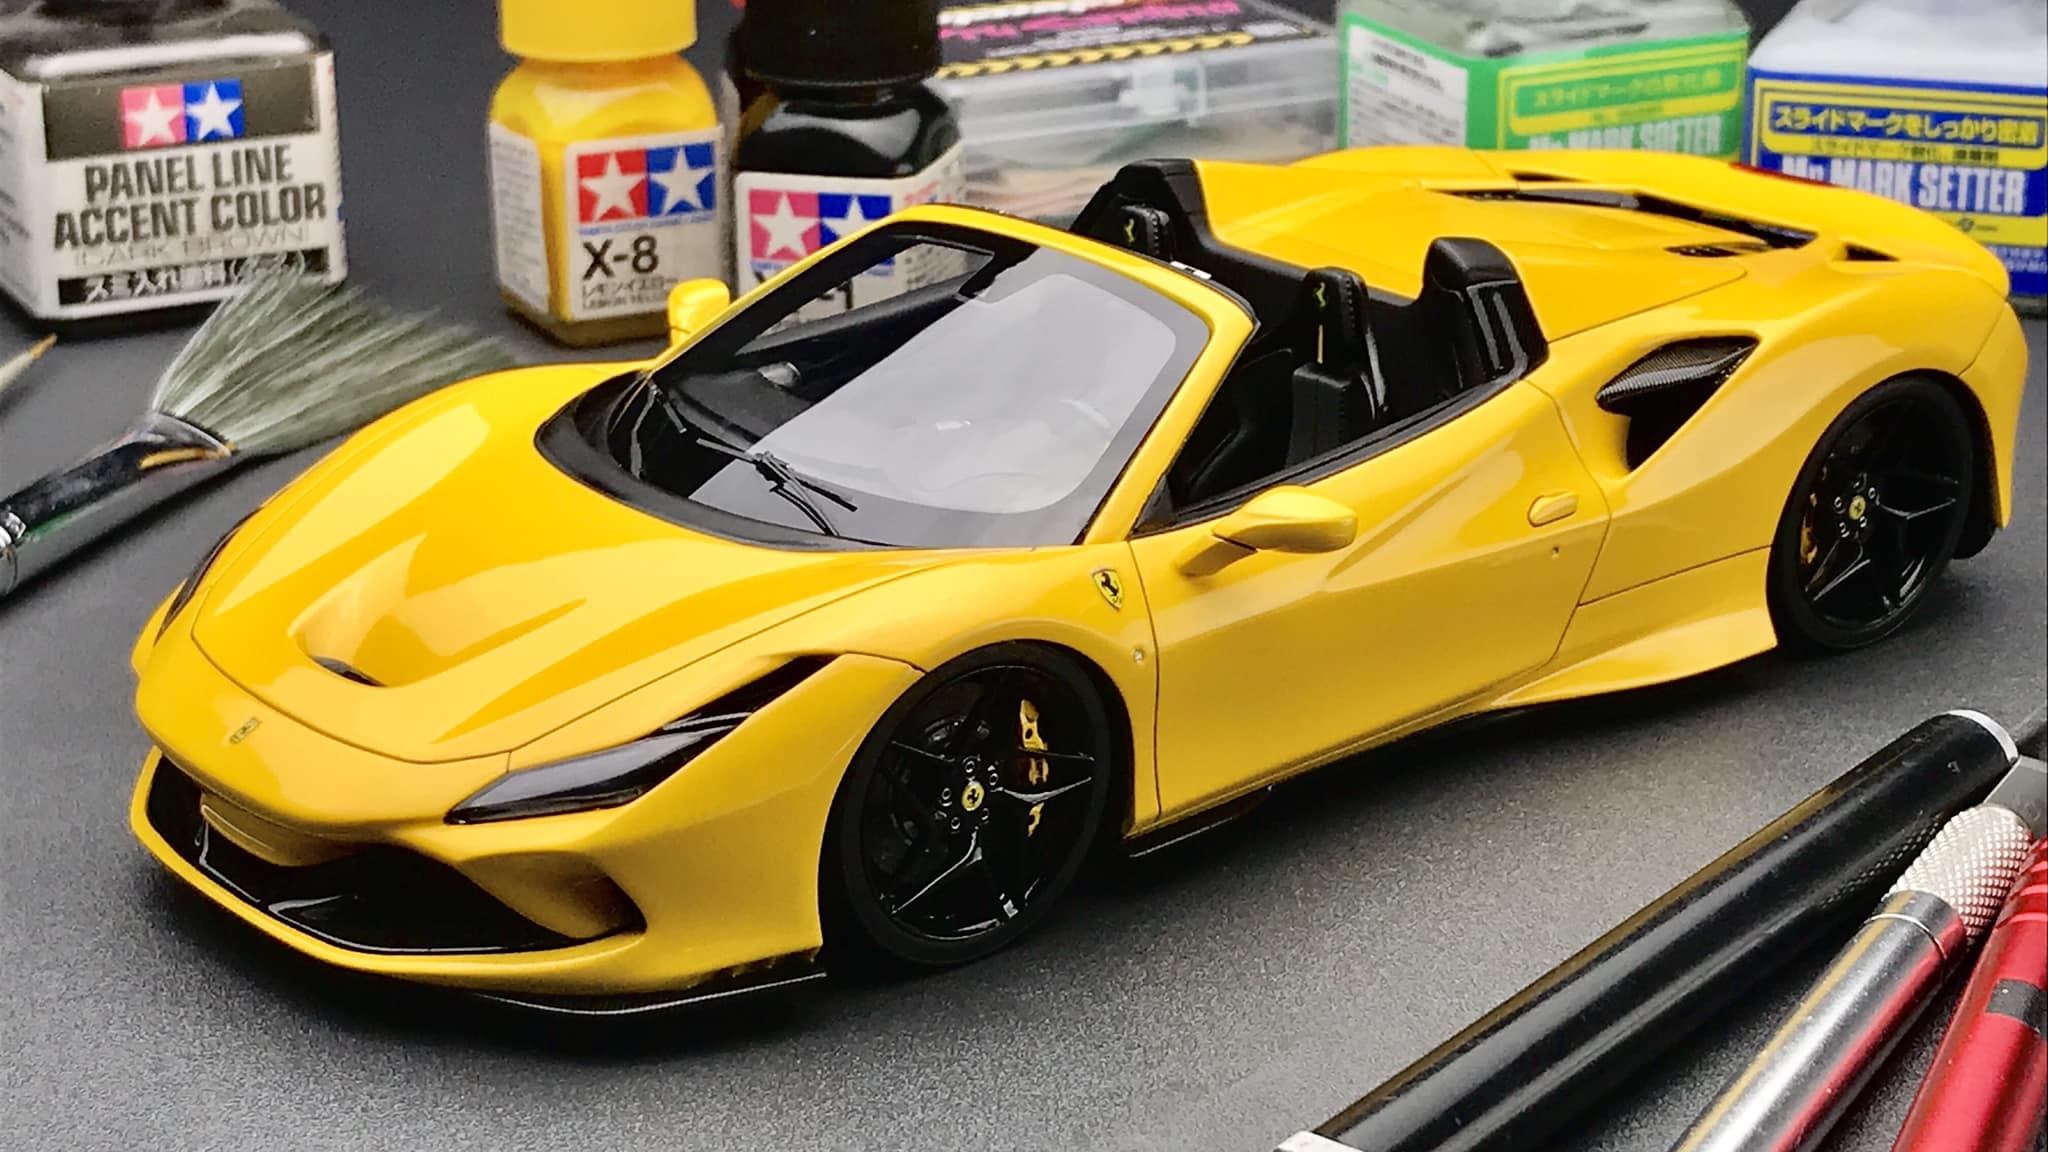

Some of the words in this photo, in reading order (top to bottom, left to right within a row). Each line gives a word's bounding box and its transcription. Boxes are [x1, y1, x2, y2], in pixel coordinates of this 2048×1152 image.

[85, 153, 204, 203] PANEL
[212, 144, 293, 188] LINE
[1830, 158, 1912, 206] MARK
[1918, 164, 2025, 214] SETTER
[54, 198, 200, 250] ACCENT
[210, 182, 328, 233] COLOR
[583, 235, 658, 280] X-8
